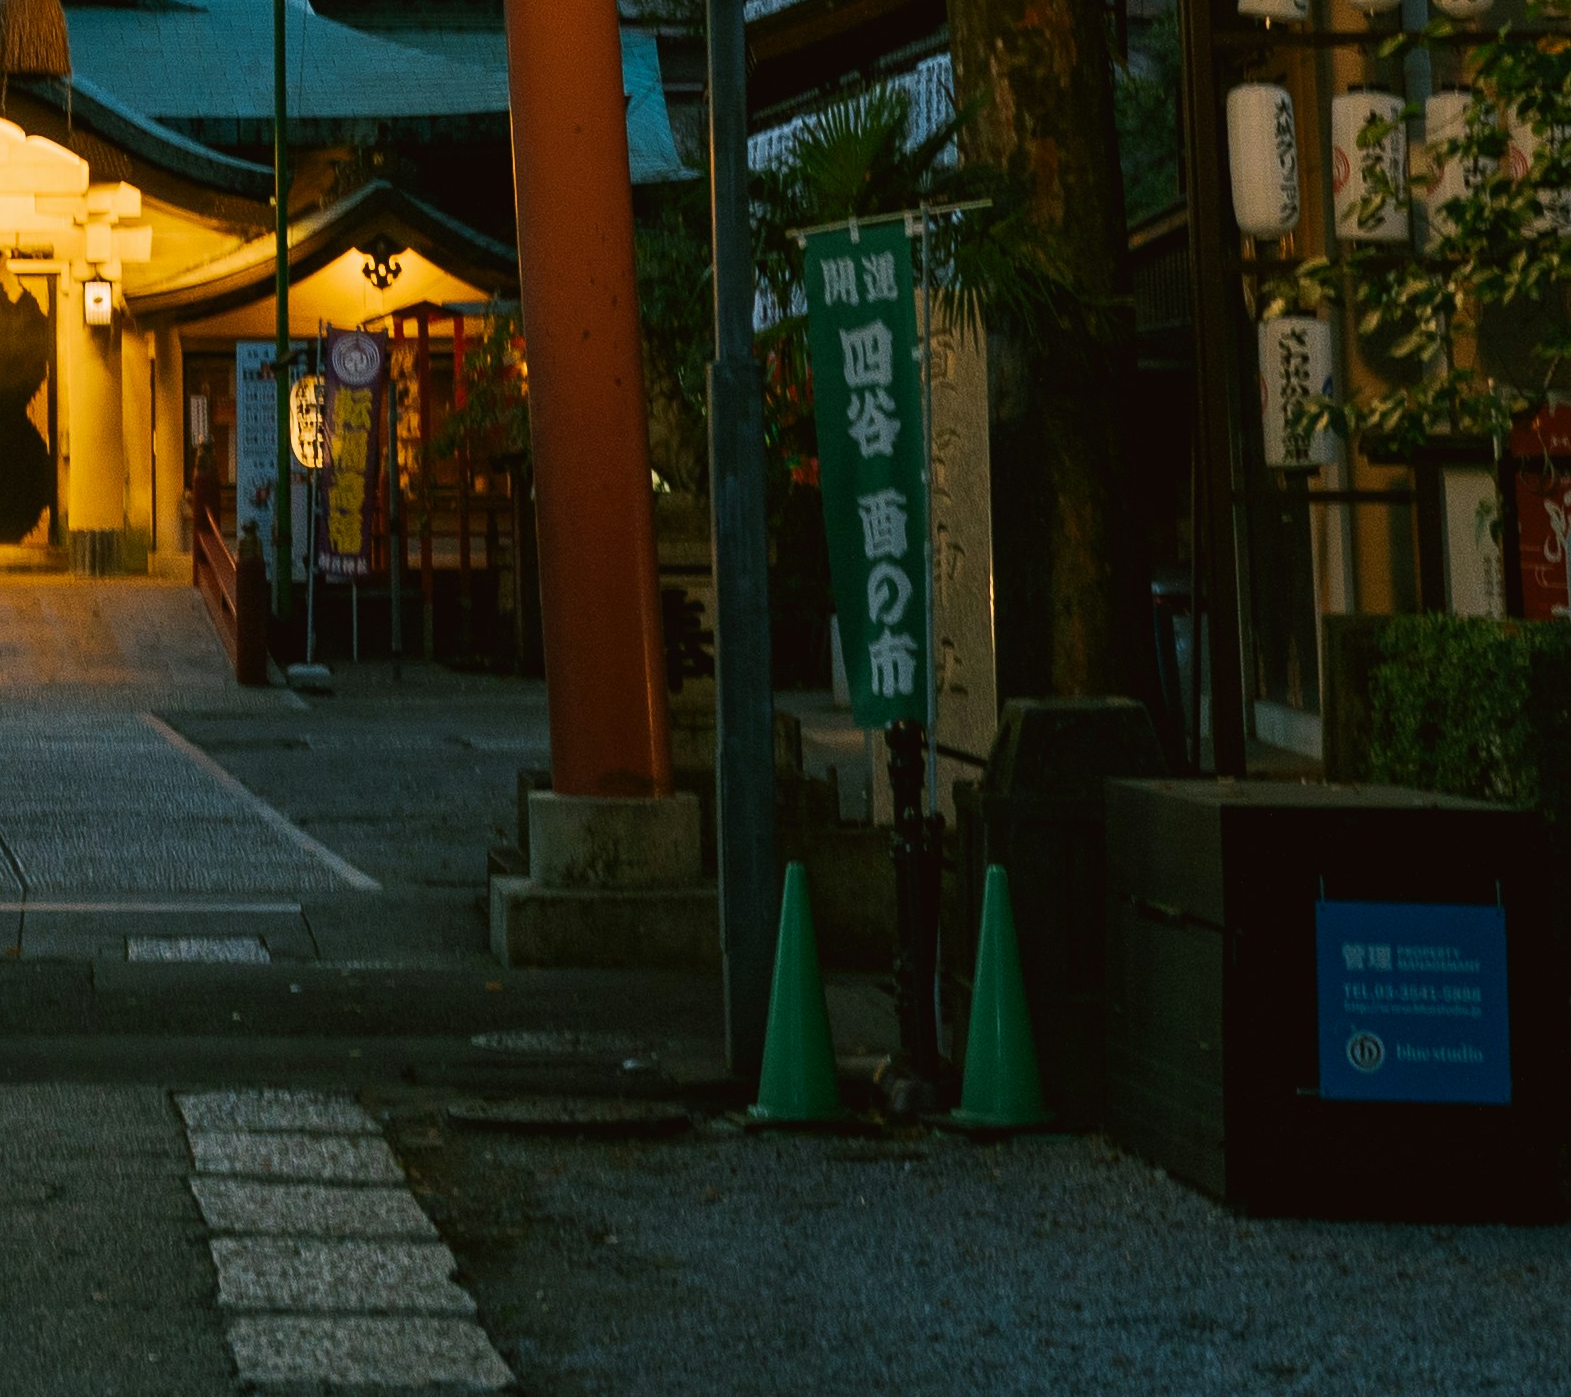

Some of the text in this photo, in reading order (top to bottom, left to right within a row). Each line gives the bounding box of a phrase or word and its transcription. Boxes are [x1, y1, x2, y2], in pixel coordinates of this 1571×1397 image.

[820, 251, 900, 307] 開運
[839, 318, 918, 699] 四谷 酉の市
